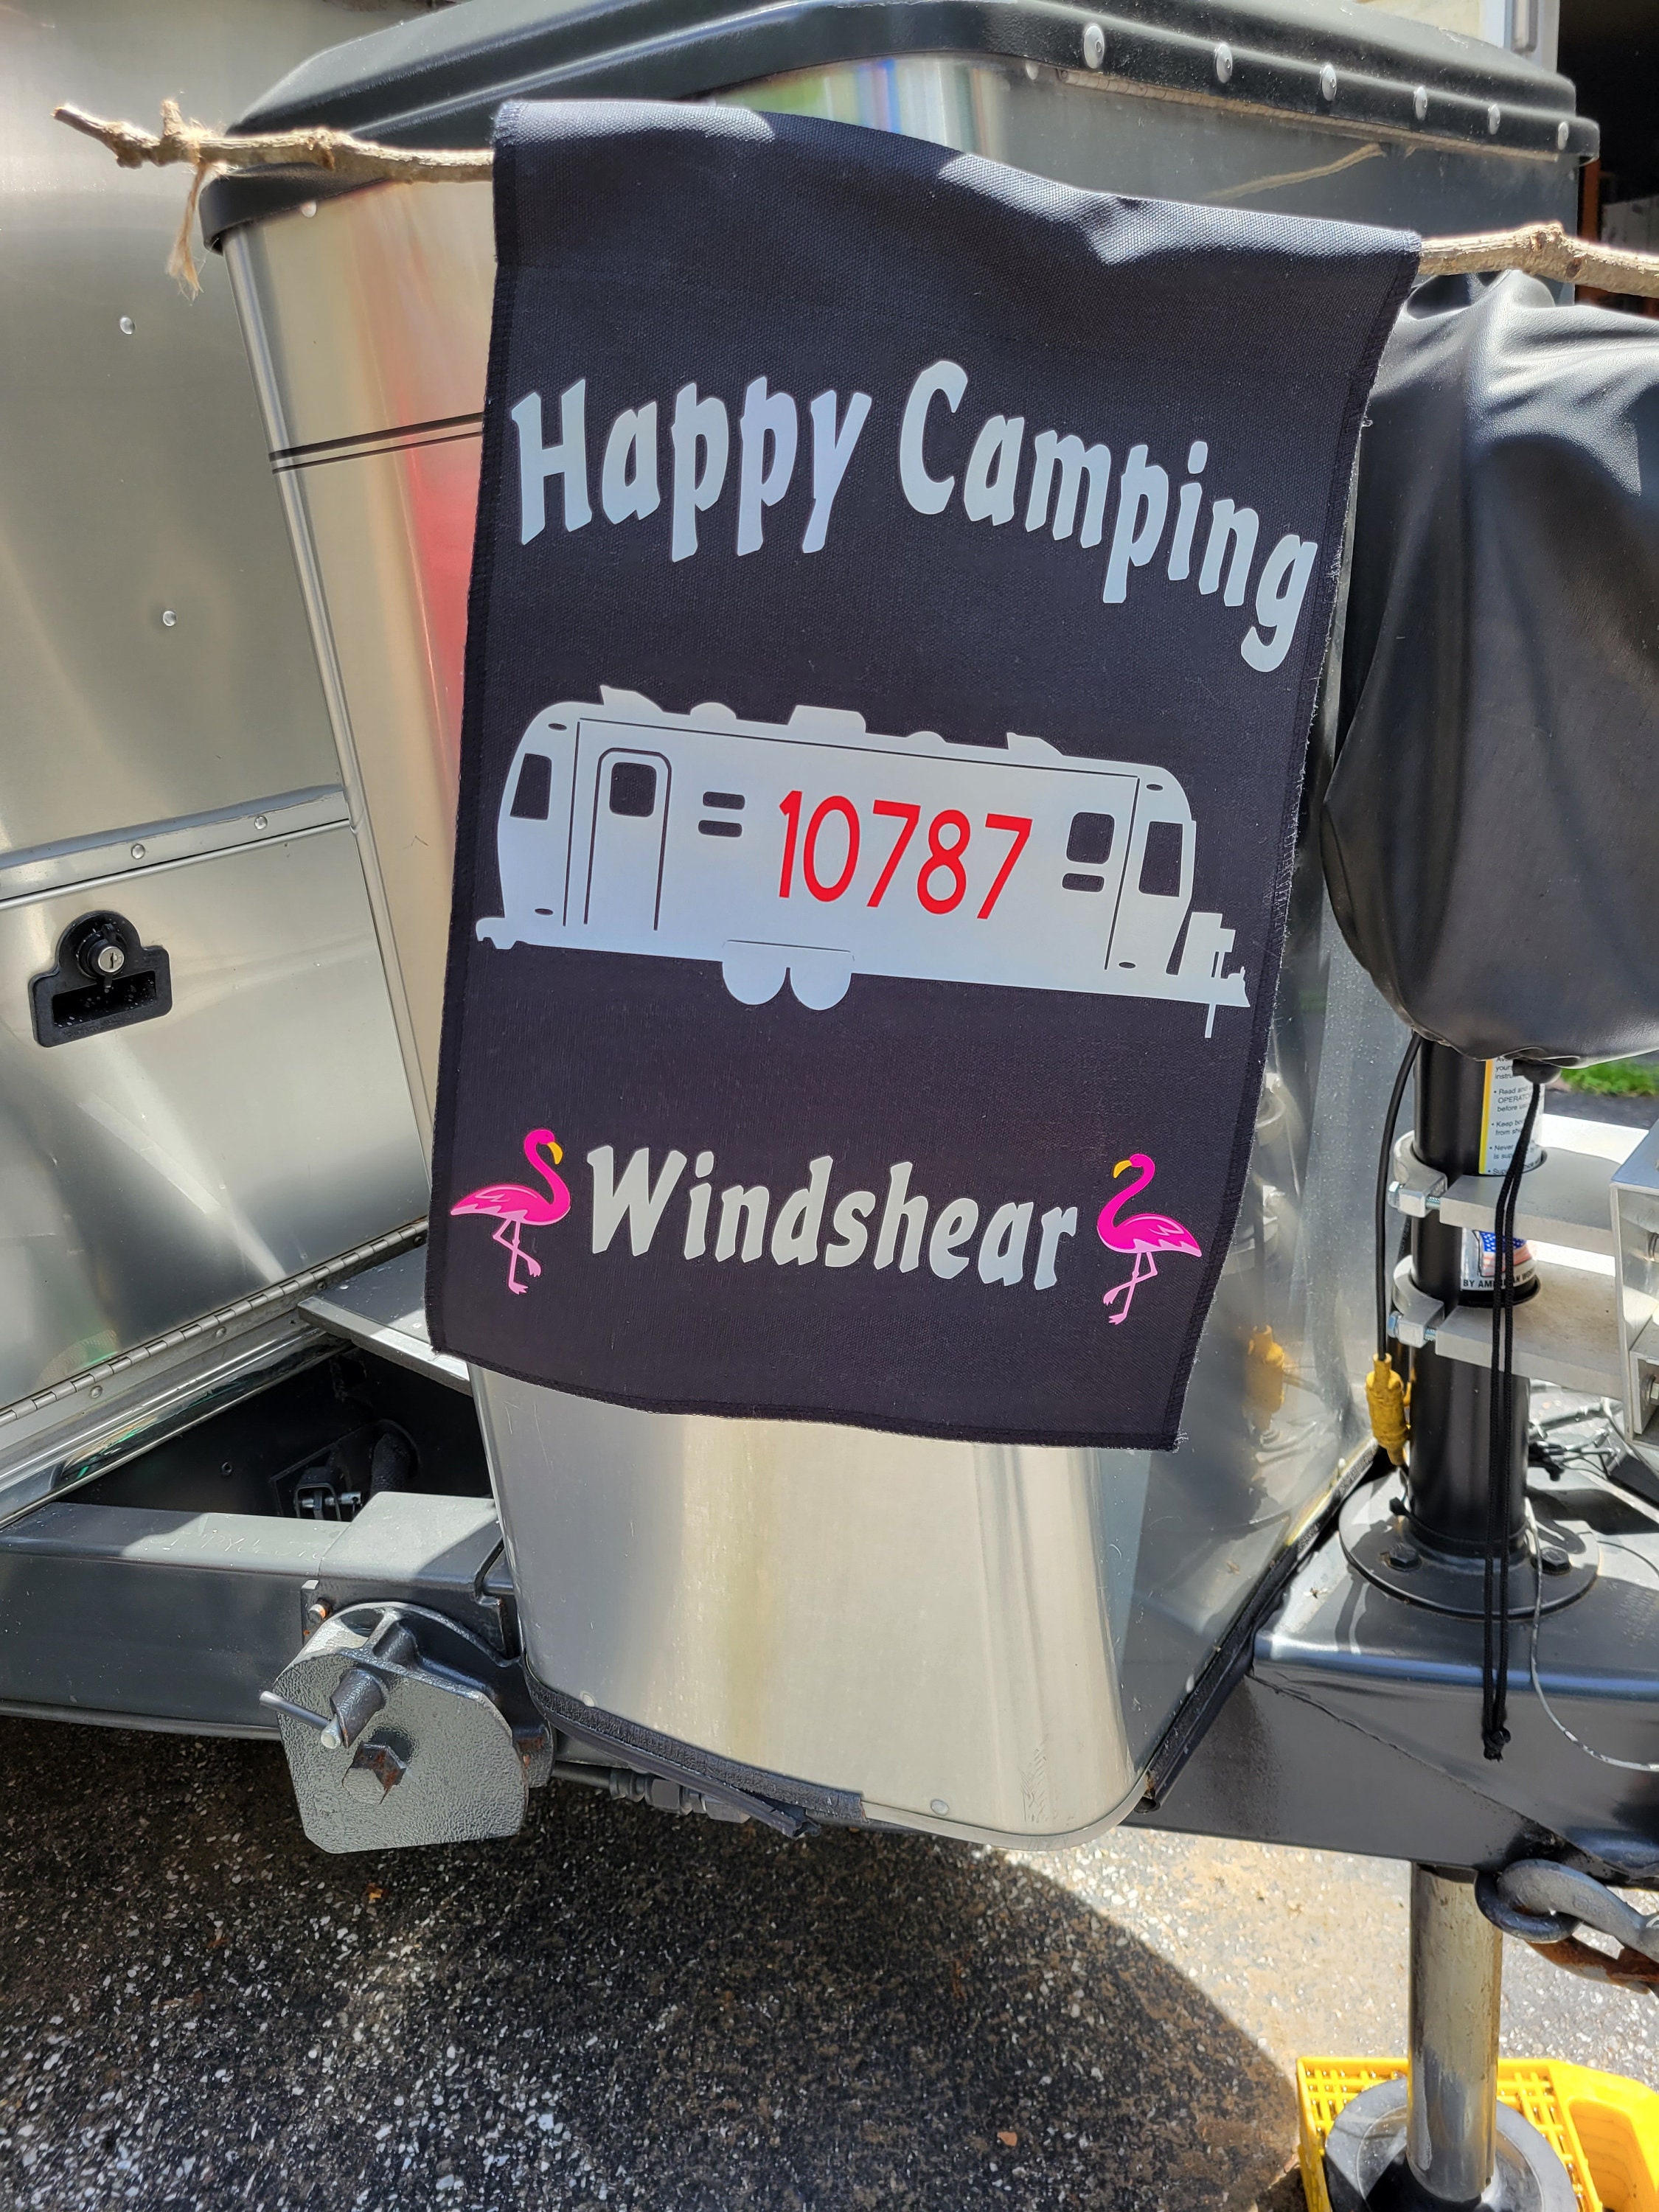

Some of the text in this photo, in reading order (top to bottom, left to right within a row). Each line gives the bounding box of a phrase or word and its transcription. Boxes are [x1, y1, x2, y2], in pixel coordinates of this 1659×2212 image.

[512, 361, 1318, 672] Happy Camping
[779, 790, 1032, 919] 10787
[587, 1145, 1077, 1290] Windshear
[1463, 1279, 1475, 1287] BY
